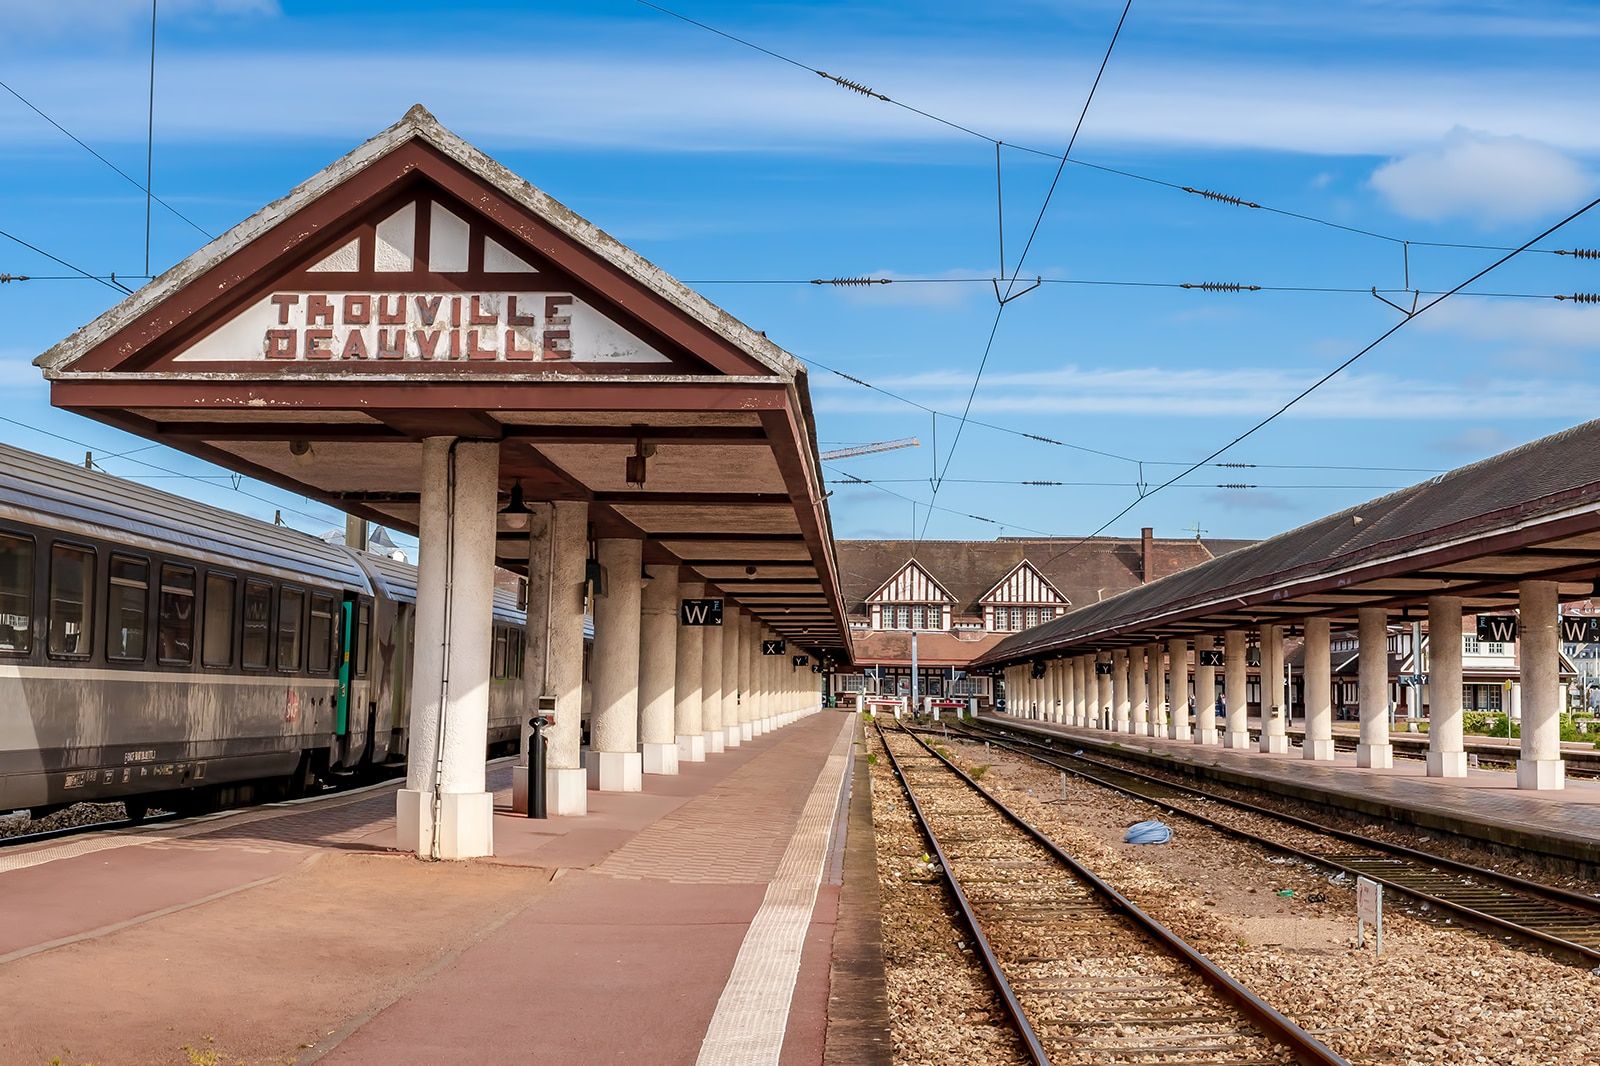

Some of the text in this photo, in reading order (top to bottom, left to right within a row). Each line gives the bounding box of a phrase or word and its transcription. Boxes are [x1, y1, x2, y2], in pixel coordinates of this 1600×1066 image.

[270, 294, 574, 326] TROUVILLE
[265, 329, 571, 360] DEAUVILLE
[684, 605, 709, 624] W
[1490, 622, 1514, 641] W
[1564, 622, 1587, 641] W
[766, 643, 775, 654] X
[795, 657, 802, 665] Y
[1210, 653, 1220, 665] X
[1102, 665, 1109, 673] Y
